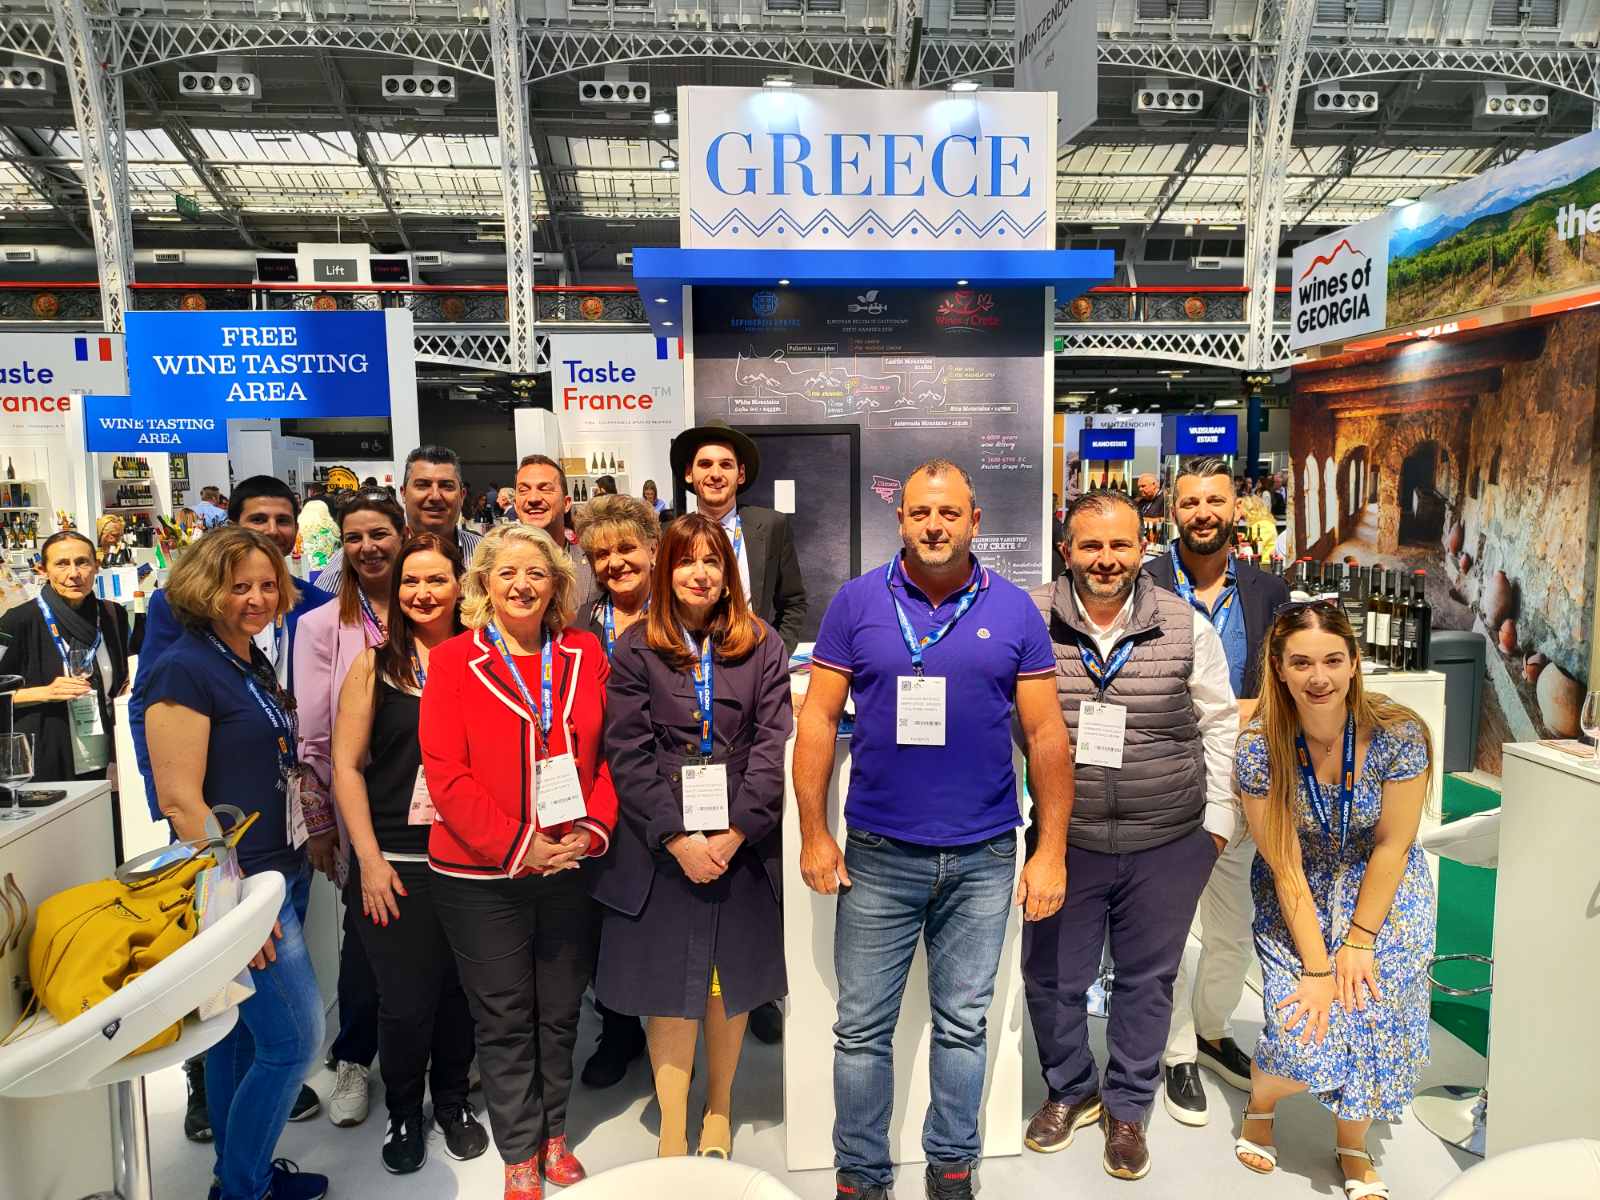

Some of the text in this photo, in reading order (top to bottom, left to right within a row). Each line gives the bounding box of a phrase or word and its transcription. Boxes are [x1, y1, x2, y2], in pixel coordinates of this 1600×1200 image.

[706, 131, 1031, 198] GREECE
[327, 265, 345, 276] Lift
[1299, 258, 1372, 306] wines of
[1297, 294, 1371, 334] GEORGIA
[222, 327, 297, 347] FREE
[153, 354, 369, 375] WINE TASTING
[563, 360, 636, 384] Taste
[226, 382, 307, 402] AREA
[563, 387, 653, 411] France
[0, 396, 71, 412] ance
[99, 418, 215, 430] WINE TASTING
[138, 433, 182, 444] AREA
